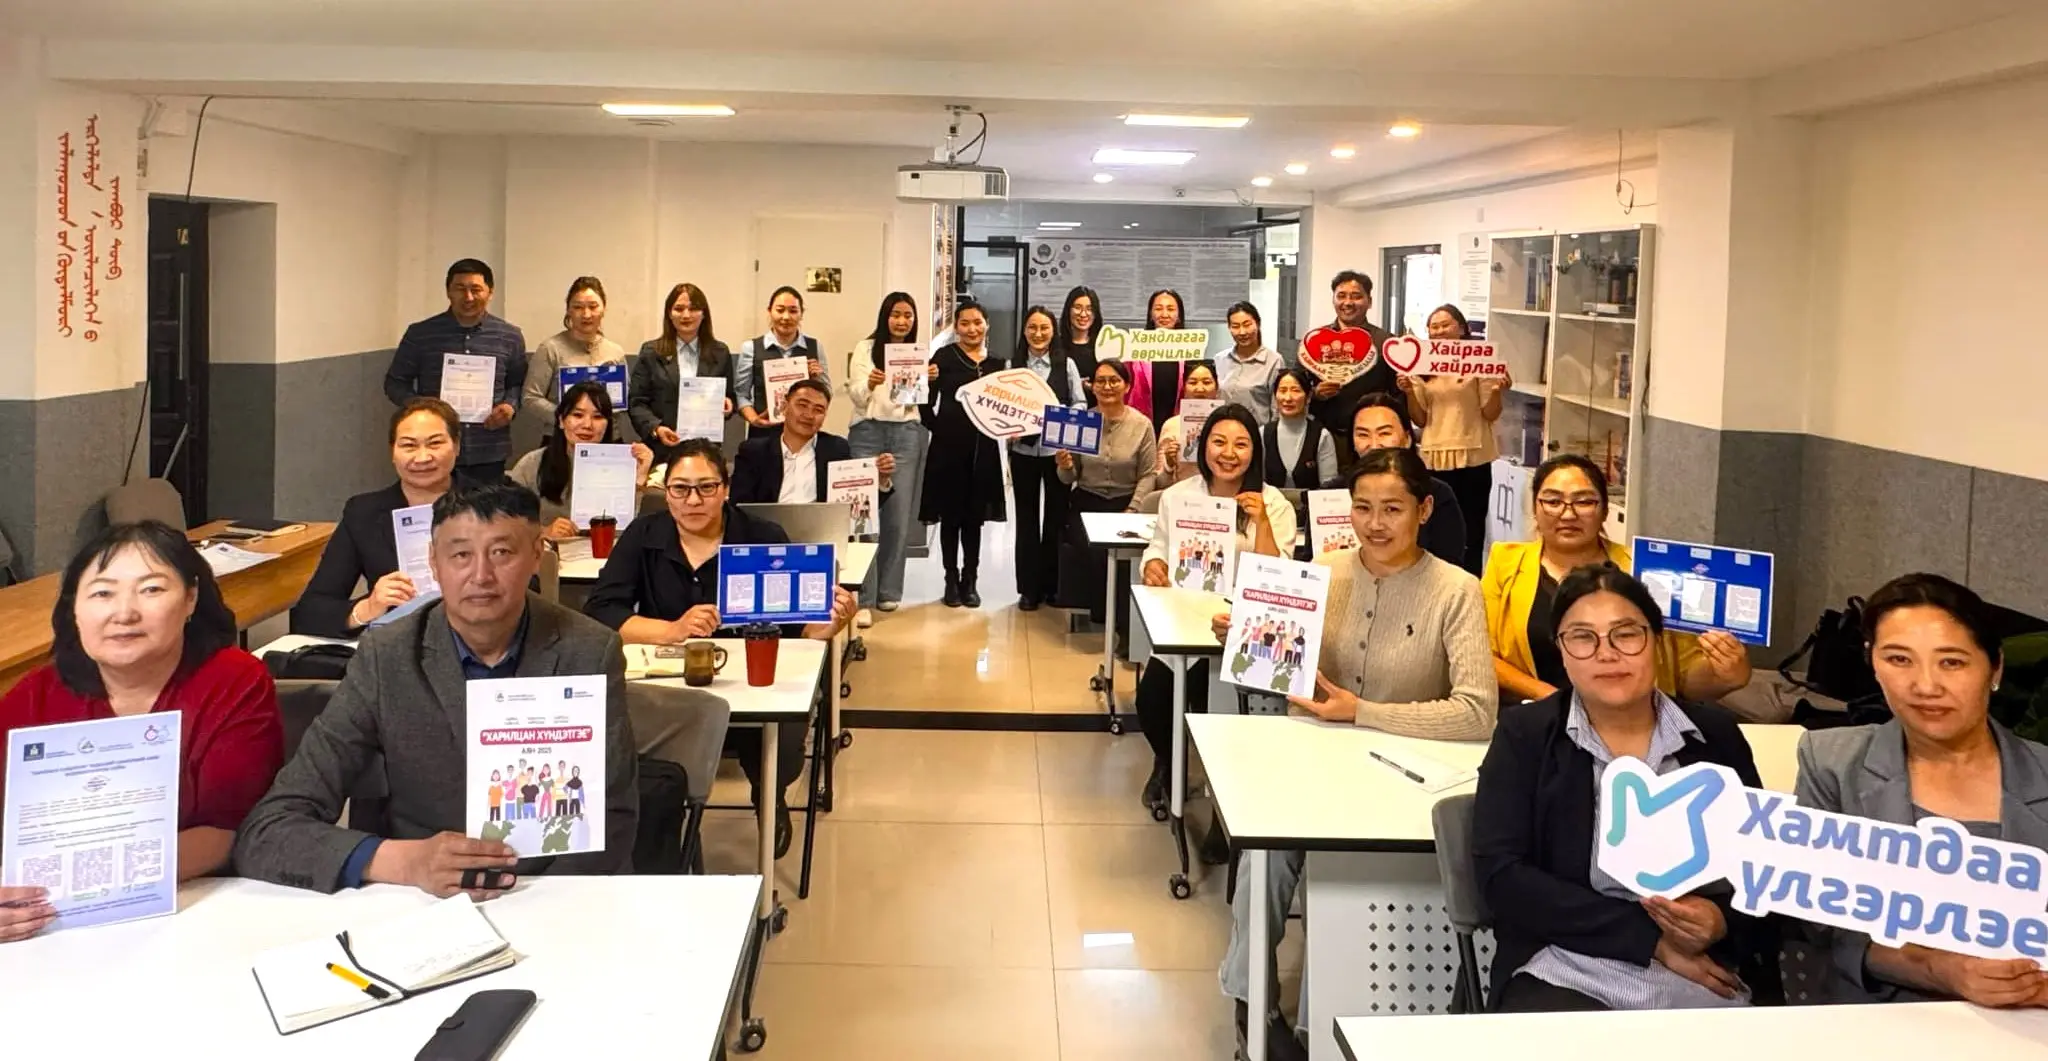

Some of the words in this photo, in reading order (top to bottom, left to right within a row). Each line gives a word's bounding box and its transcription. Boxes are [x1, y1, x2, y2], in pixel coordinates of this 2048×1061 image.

[1131, 330, 1206, 344] Хандлагаа
[1429, 341, 1494, 359] Хайраа
[1430, 358, 1506, 376] хайрлая
[1738, 792, 2042, 892] Хамтдаа
[1741, 860, 2048, 957] үлгэрлэе
